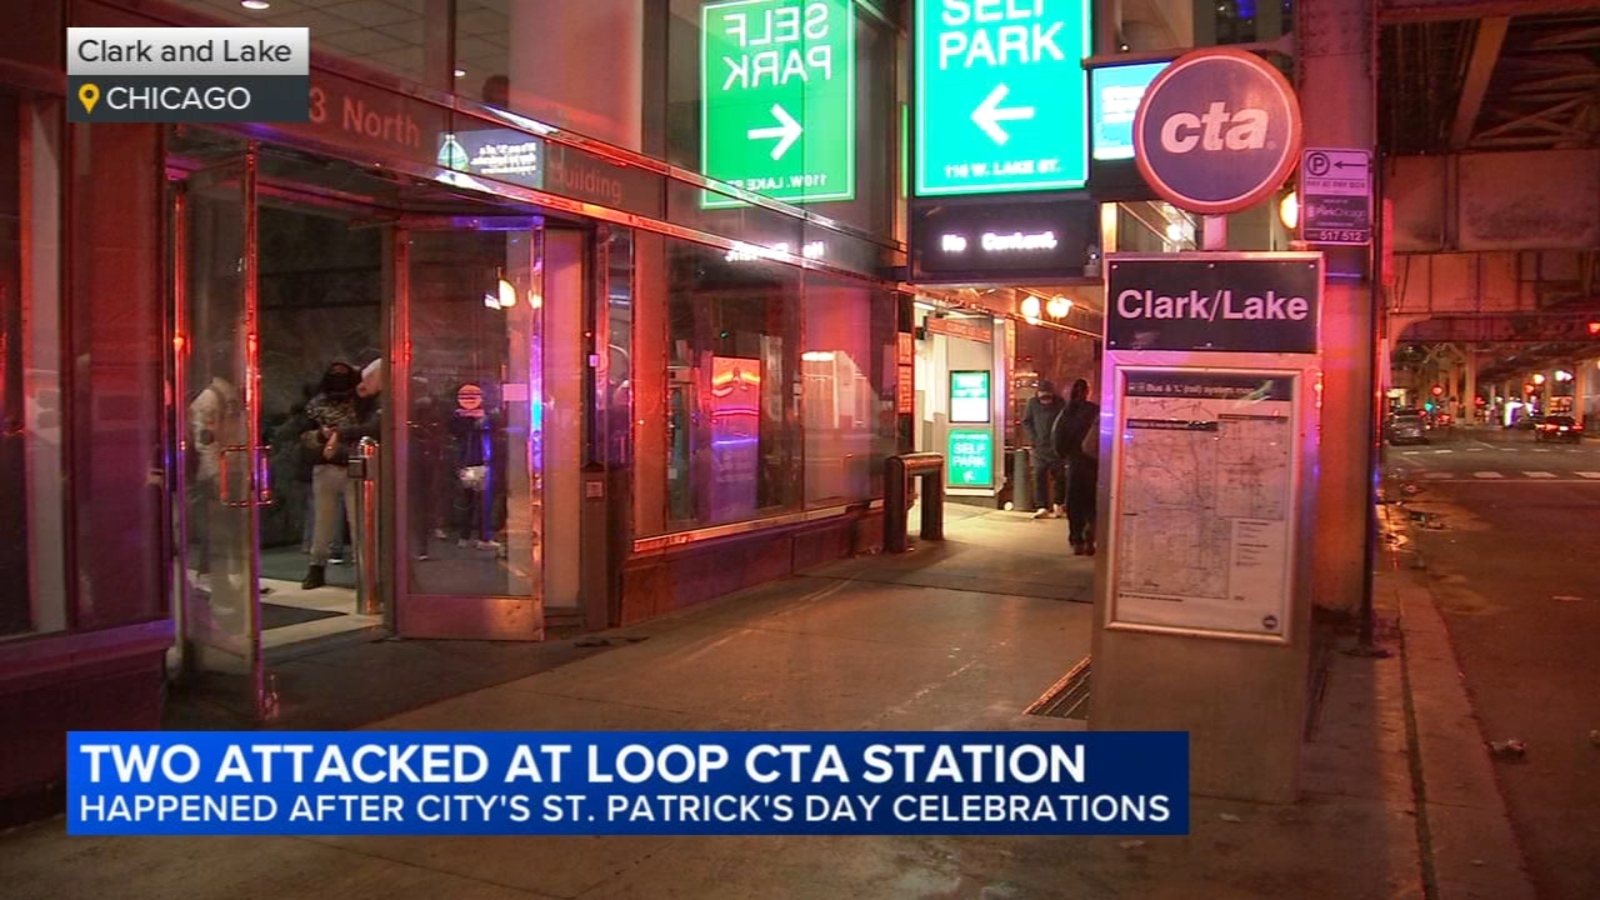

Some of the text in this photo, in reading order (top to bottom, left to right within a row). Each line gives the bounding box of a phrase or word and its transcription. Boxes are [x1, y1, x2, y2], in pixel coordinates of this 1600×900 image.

[939, 21, 1066, 70] PARK
[342, 99, 421, 147] North
[1160, 101, 1270, 154] cta
[993, 159, 1035, 177] LAKE
[1117, 290, 1309, 322] Clark/Lake
